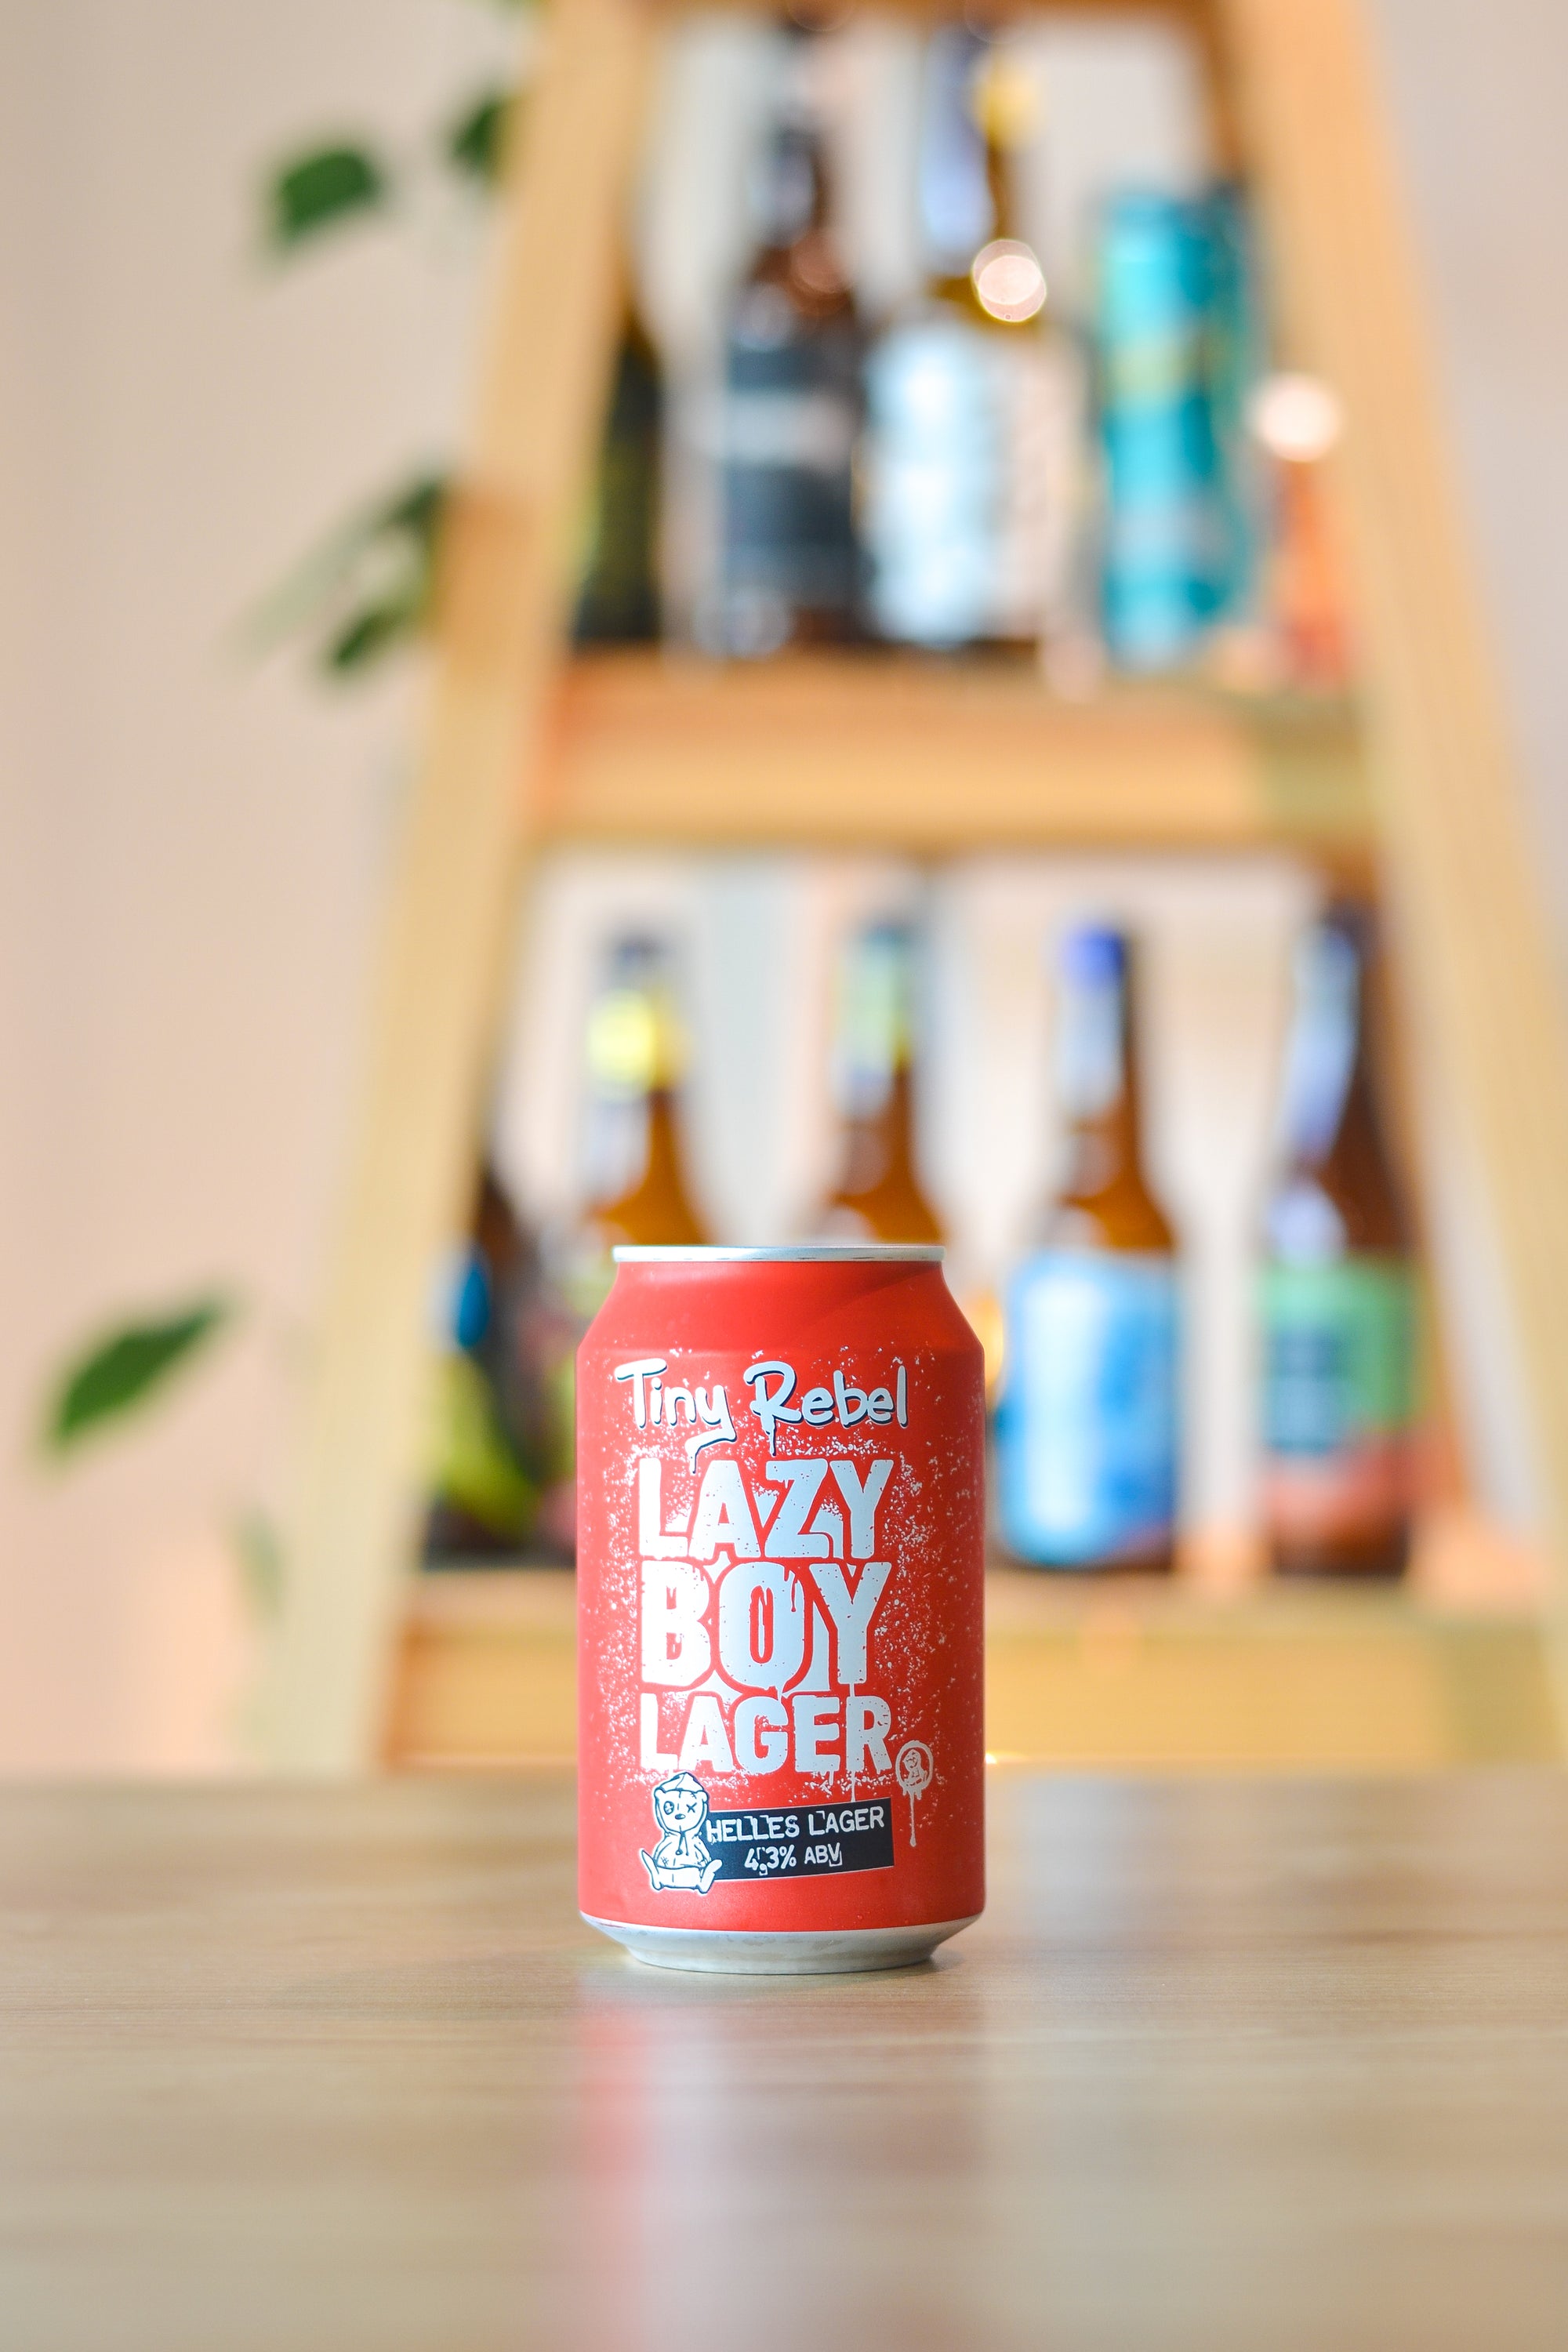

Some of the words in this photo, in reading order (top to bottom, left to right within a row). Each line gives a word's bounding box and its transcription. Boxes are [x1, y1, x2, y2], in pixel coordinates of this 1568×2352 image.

[615, 1358, 736, 1474] Tiny
[743, 1361, 908, 1456] Rebel
[639, 1458, 894, 1560] LAZY
[641, 1562, 892, 1692] BOY
[640, 1693, 892, 1774] LAGER
[706, 1815, 799, 1843] HELLES
[808, 1806, 884, 1836] LAGER
[804, 1842, 842, 1867] ABV
